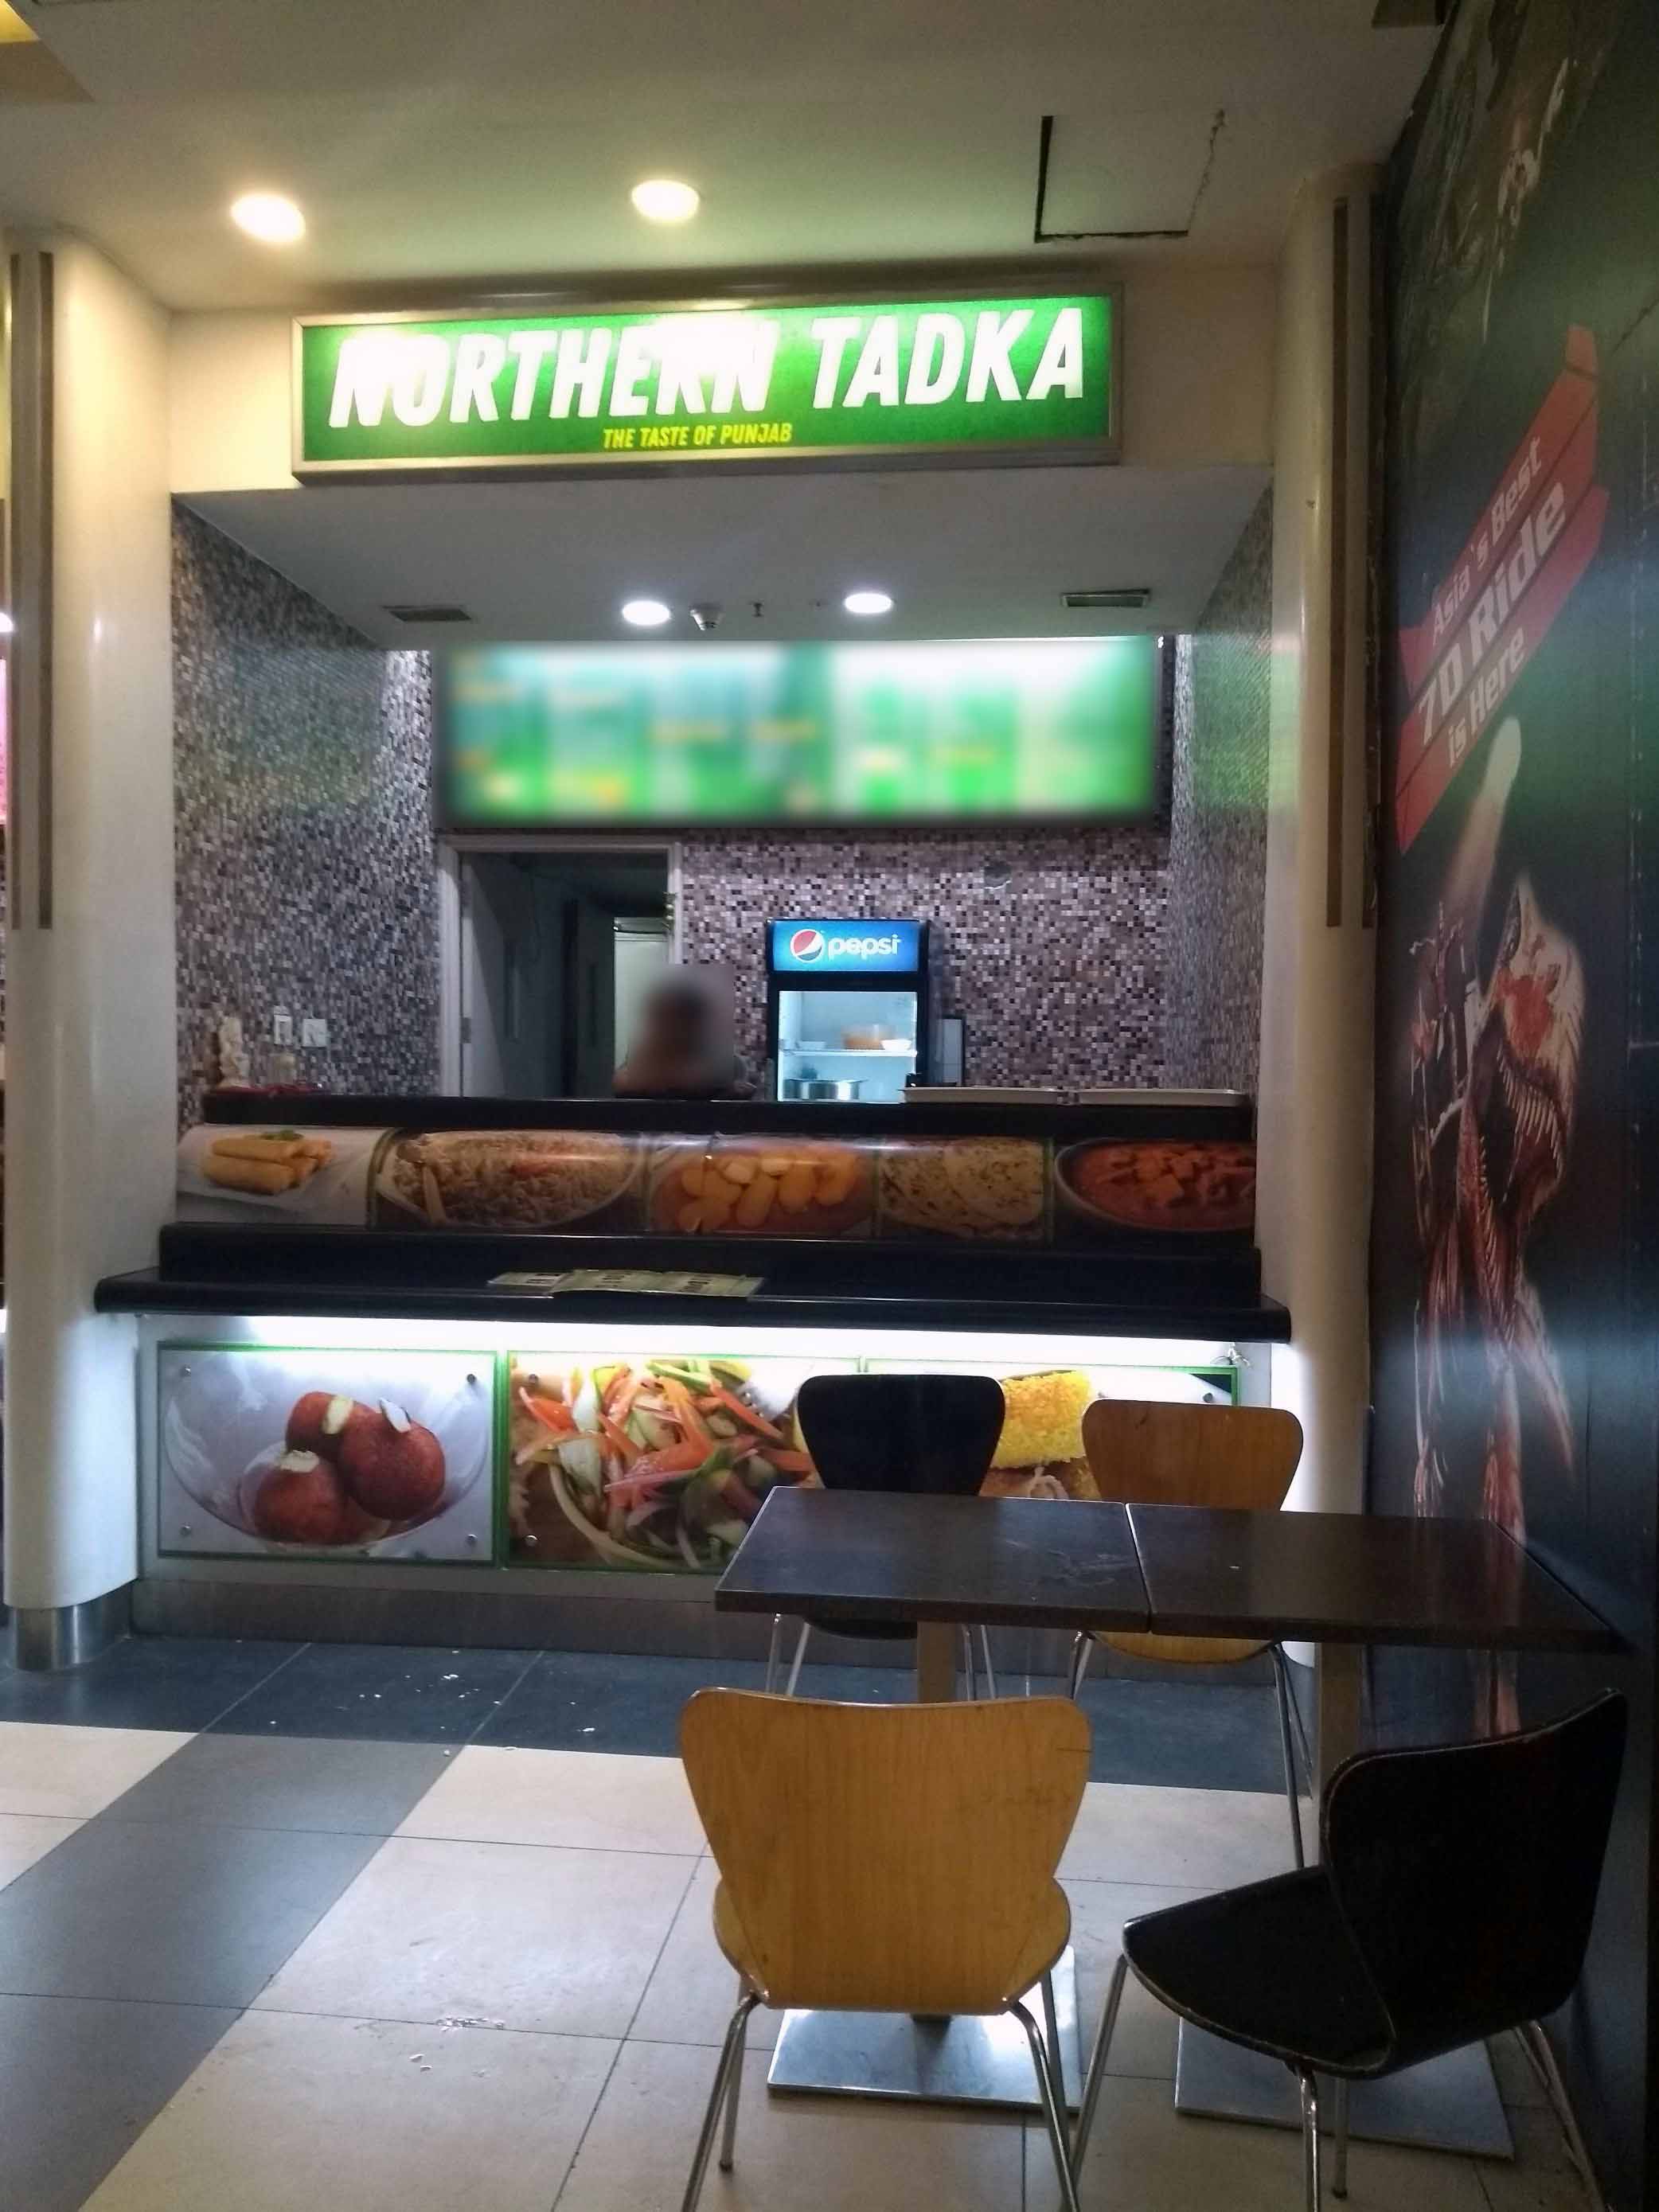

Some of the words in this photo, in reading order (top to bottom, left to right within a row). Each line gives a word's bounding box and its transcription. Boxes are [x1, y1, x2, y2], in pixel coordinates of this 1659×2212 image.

[328, 320, 780, 427] NORTHERN
[810, 307, 1083, 408] TADKA
[603, 428, 635, 449] THE
[639, 426, 689, 448] TASTE
[693, 424, 716, 446] OF
[720, 422, 793, 445] PUNJAB
[1491, 435, 1542, 546] Best
[1419, 642, 1464, 746] 7D
[1469, 482, 1566, 667] Ride
[1448, 717, 1467, 768] is
[1470, 626, 1525, 737] Here
[827, 934, 902, 960] pepsi
